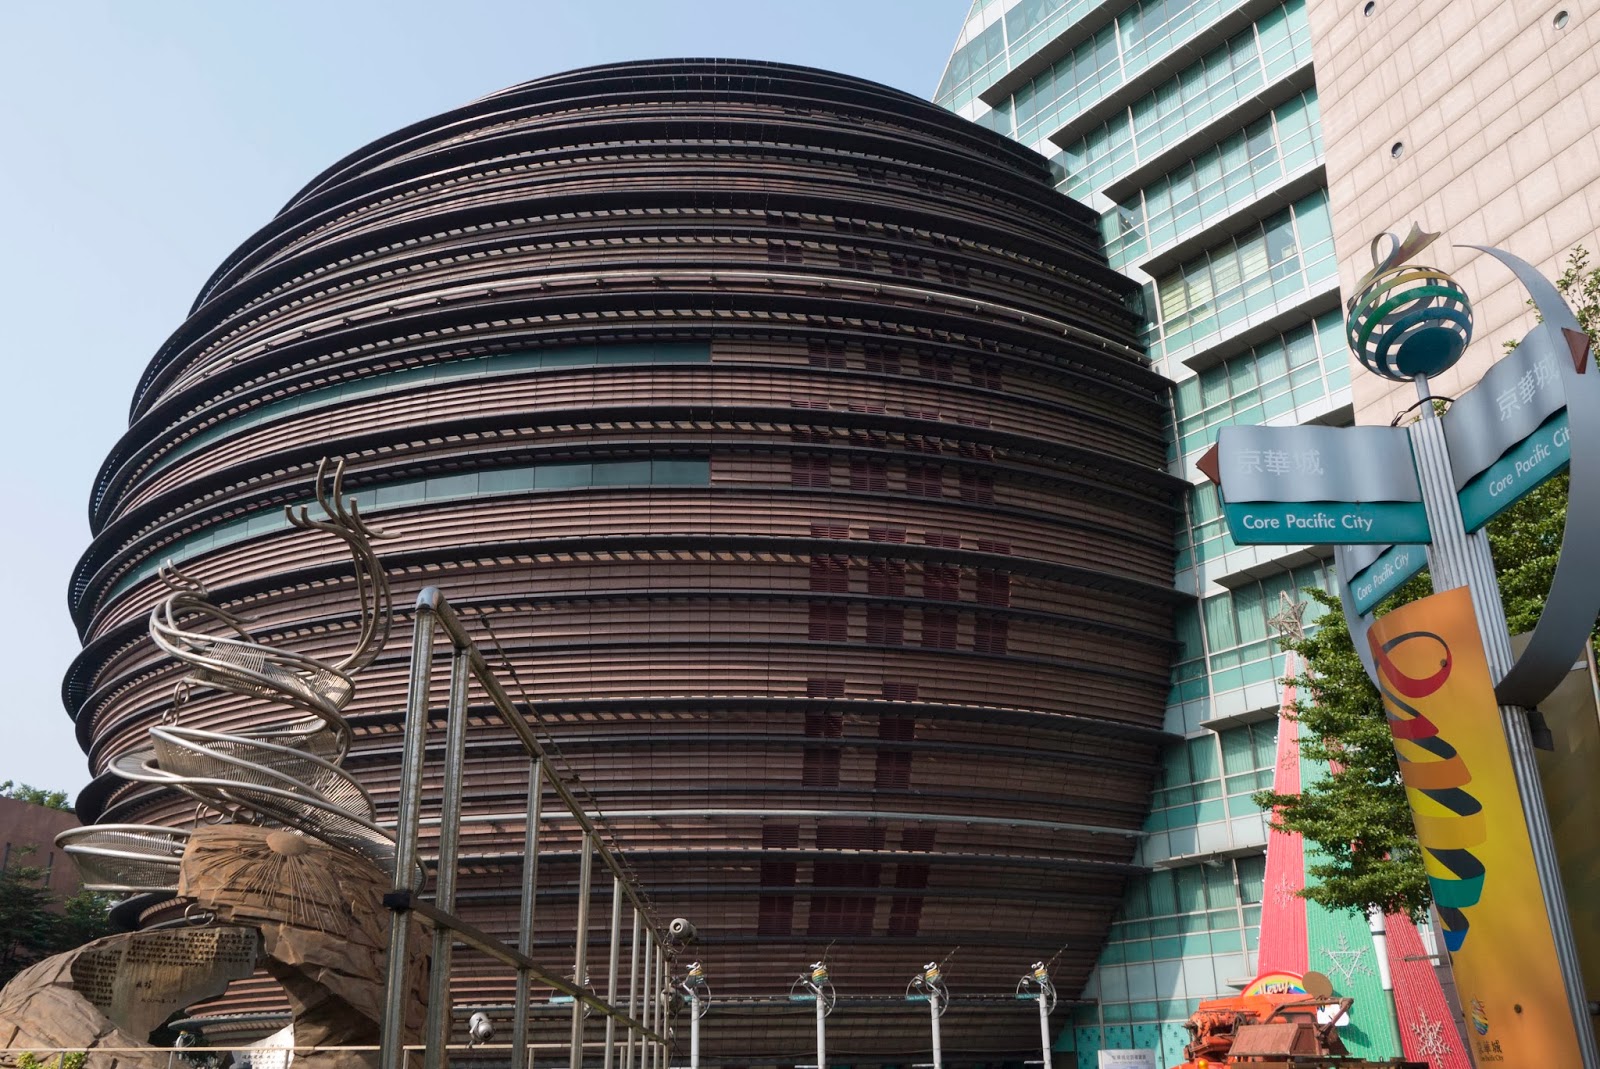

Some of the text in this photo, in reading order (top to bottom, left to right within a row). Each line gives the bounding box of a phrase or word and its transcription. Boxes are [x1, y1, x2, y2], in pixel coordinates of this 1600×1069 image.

[1497, 352, 1560, 420] 京華城
[1235, 448, 1324, 476] 京華城
[1489, 426, 1570, 497] Core Pacific Cit
[1243, 512, 1373, 532] Core Pacific City
[1357, 553, 1409, 600] Core Pacific City
